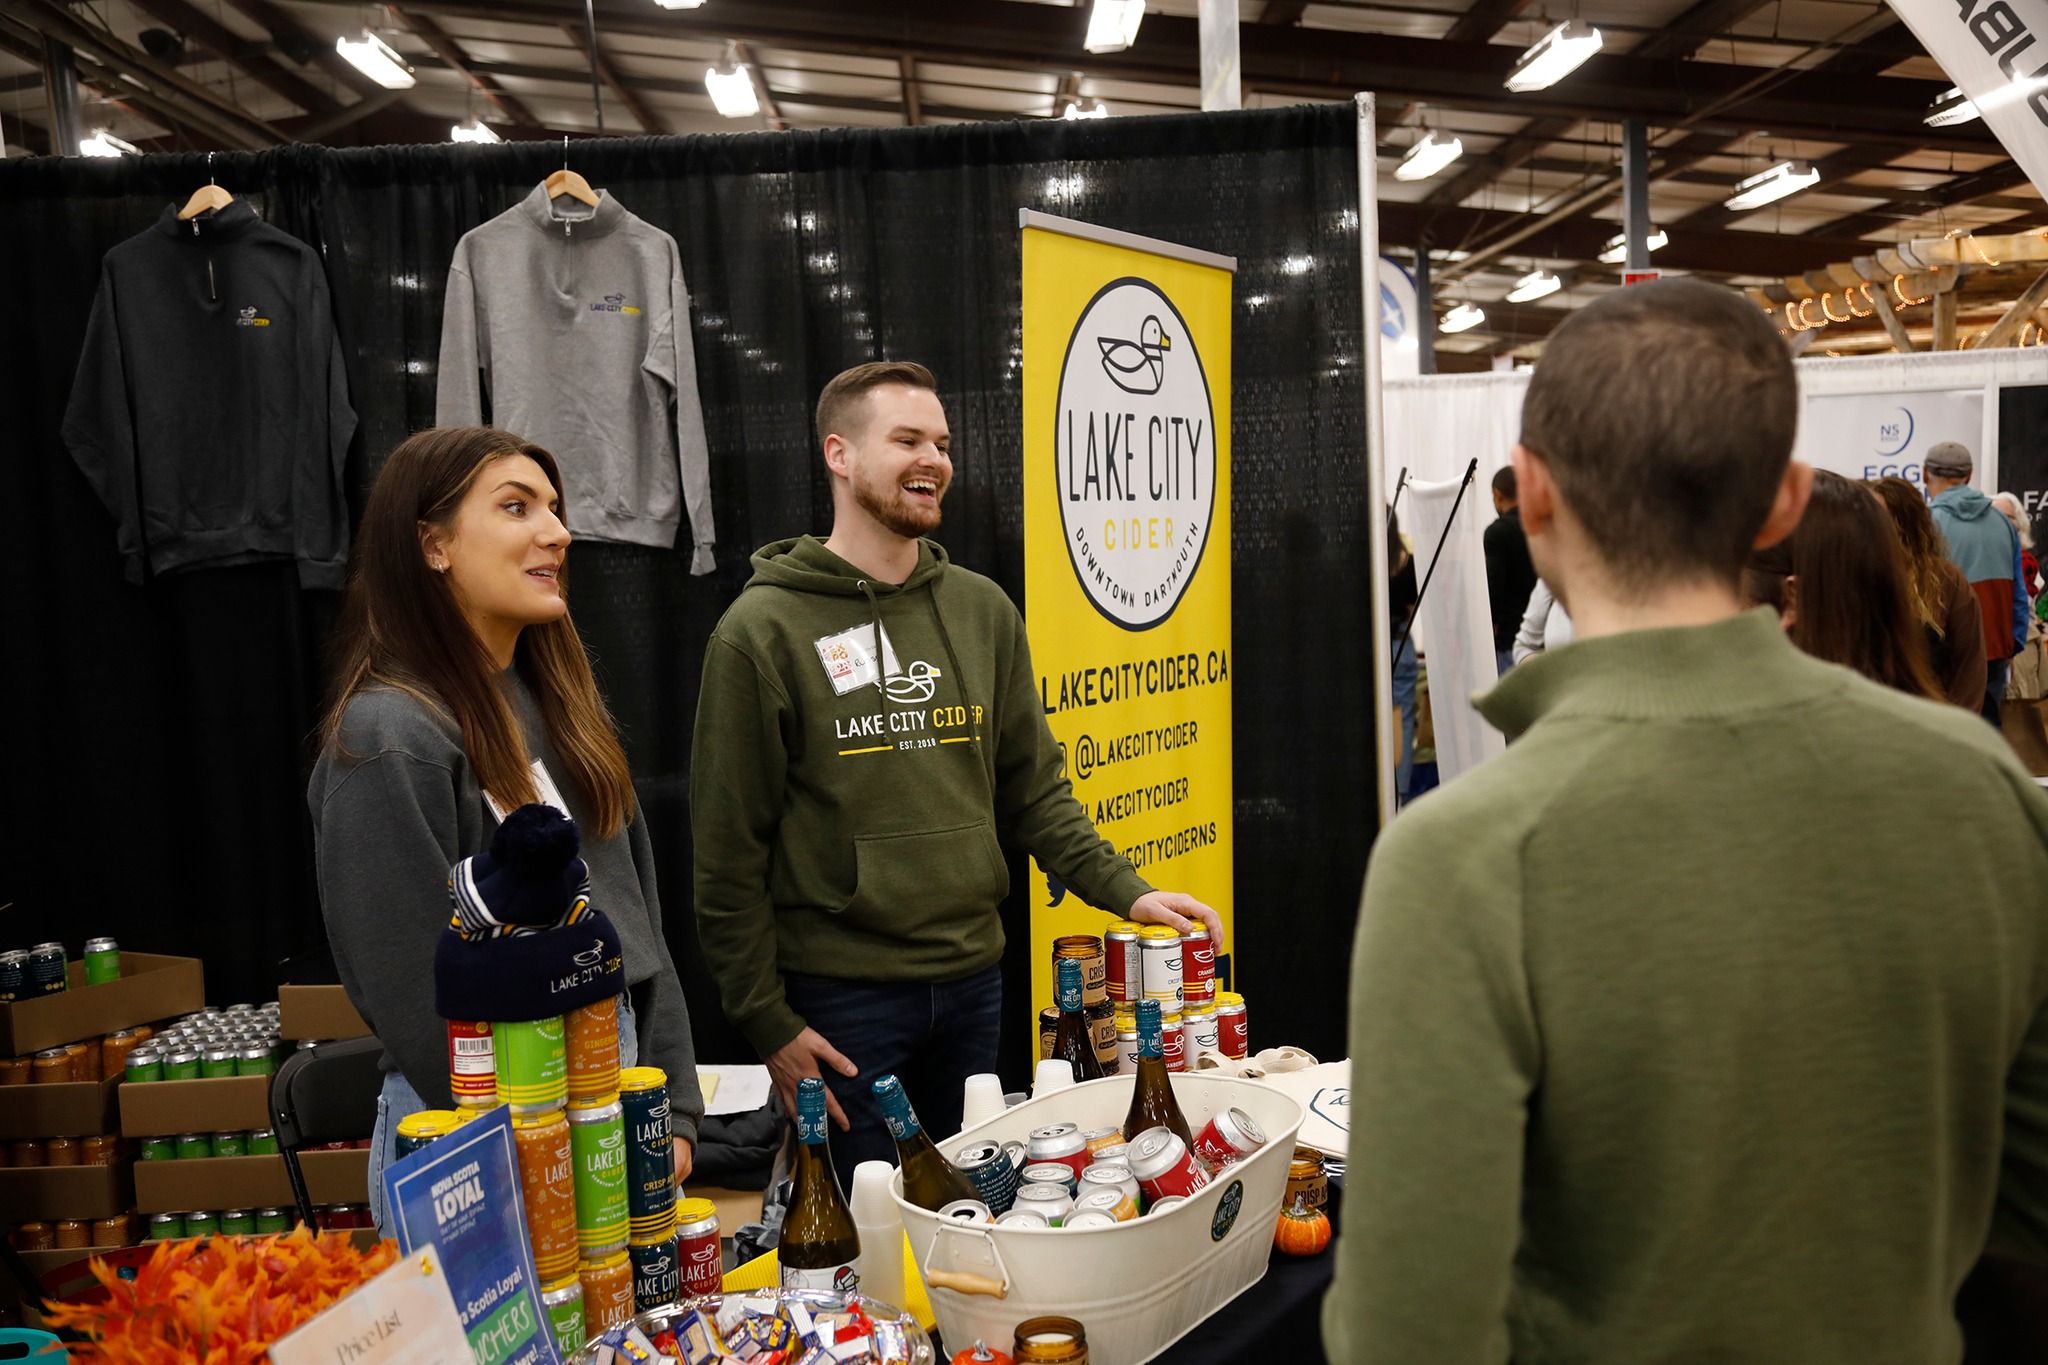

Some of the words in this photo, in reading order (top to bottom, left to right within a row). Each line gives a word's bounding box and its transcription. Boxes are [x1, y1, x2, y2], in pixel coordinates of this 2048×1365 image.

[1069, 409, 1136, 501] LAKE
[1149, 415, 1202, 501] CITY
[1104, 517, 1174, 551] CIDER
[1076, 527, 1135, 608] DOWNTOWN
[1145, 522, 1199, 607] DARTMOUTH
[1041, 649, 1229, 715] LAKECITYCIDER.CA
[835, 714, 885, 739] LAKE
[889, 709, 926, 733] CITY
[899, 740, 916, 750] EST.
[917, 738, 937, 748] 2018
[1075, 720, 1198, 780] @LAKECITYCIDER
[551, 972, 579, 993] LAKE
[581, 964, 603, 983] CITY
[637, 1120, 663, 1142] LAKE
[545, 1160, 569, 1185] LAKE
[587, 1150, 614, 1172] LAKE
[431, 1176, 454, 1199] NOVA
[452, 1160, 480, 1186] SCOTIA
[643, 1177, 667, 1192] CRISP
[434, 1175, 485, 1226] LOYAL
[681, 1263, 706, 1282] LAKE
[467, 1288, 498, 1319] Scotia
[497, 1265, 522, 1297] Loyal
[645, 1292, 673, 1305] CIDER
[379, 1309, 403, 1341] List
